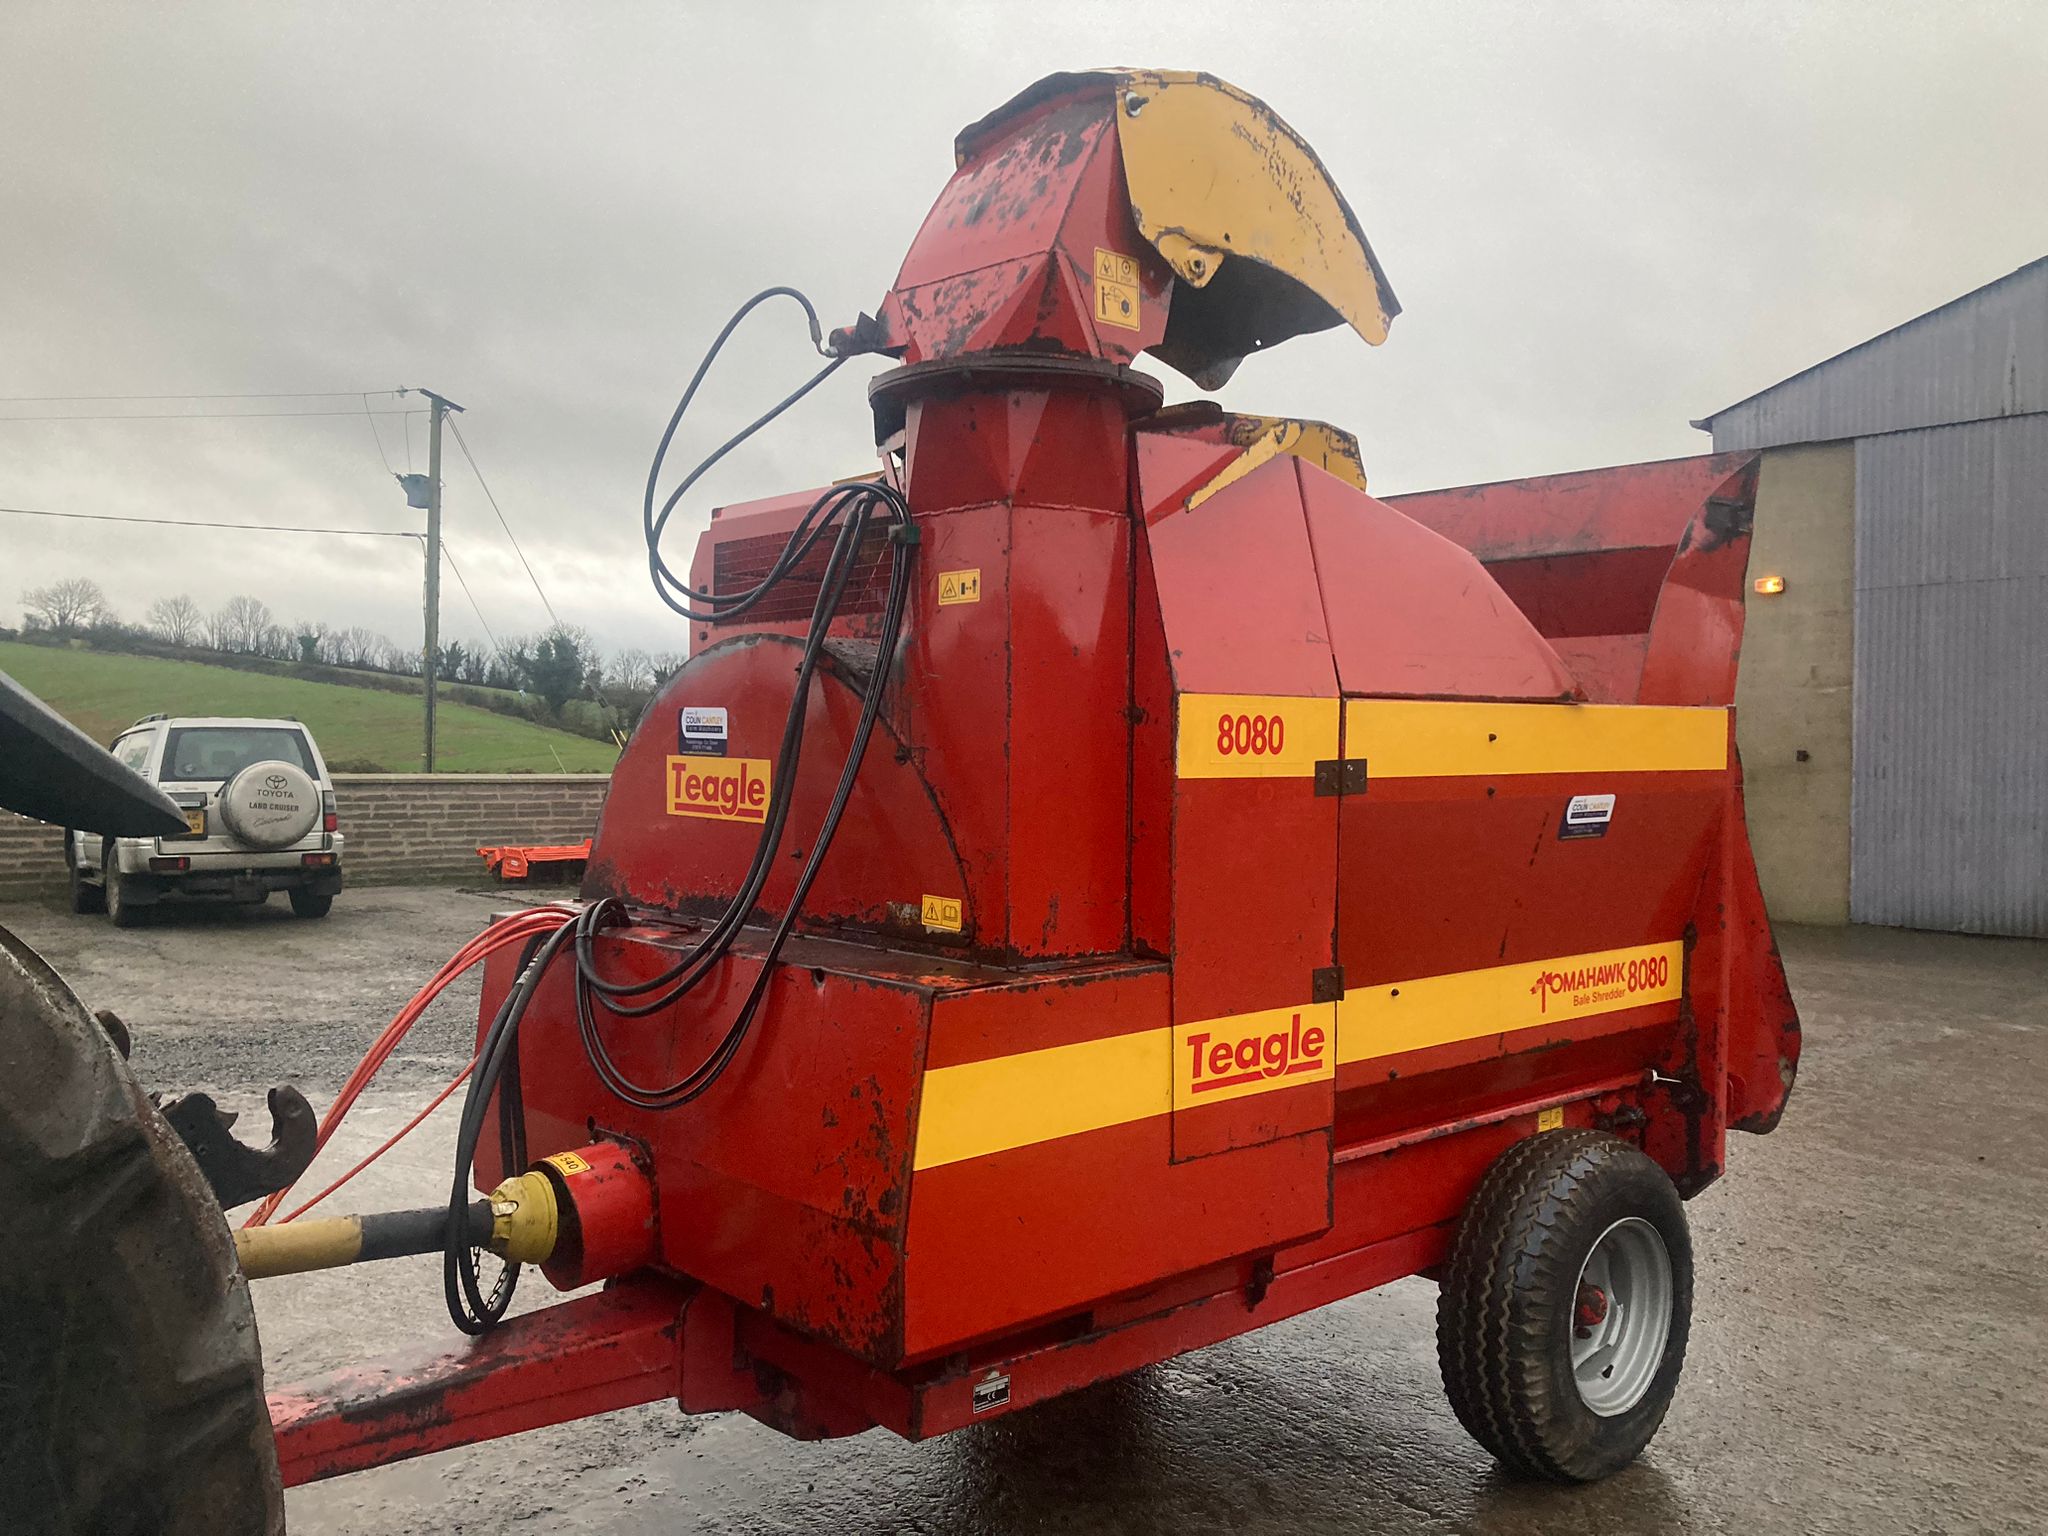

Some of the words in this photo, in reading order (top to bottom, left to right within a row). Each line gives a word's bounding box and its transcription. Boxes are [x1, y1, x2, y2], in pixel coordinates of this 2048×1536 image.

[1217, 714, 1284, 755] 8080
[249, 801, 268, 810] LAND
[269, 802, 299, 812] CRUISER
[257, 789, 294, 799] TOYOTA
[672, 763, 766, 816] Teagle
[1627, 955, 1668, 992] 8080
[1573, 994, 1591, 1007] Bale
[1592, 988, 1626, 1003] Shredder
[1187, 1013, 1325, 1078] Teagle
